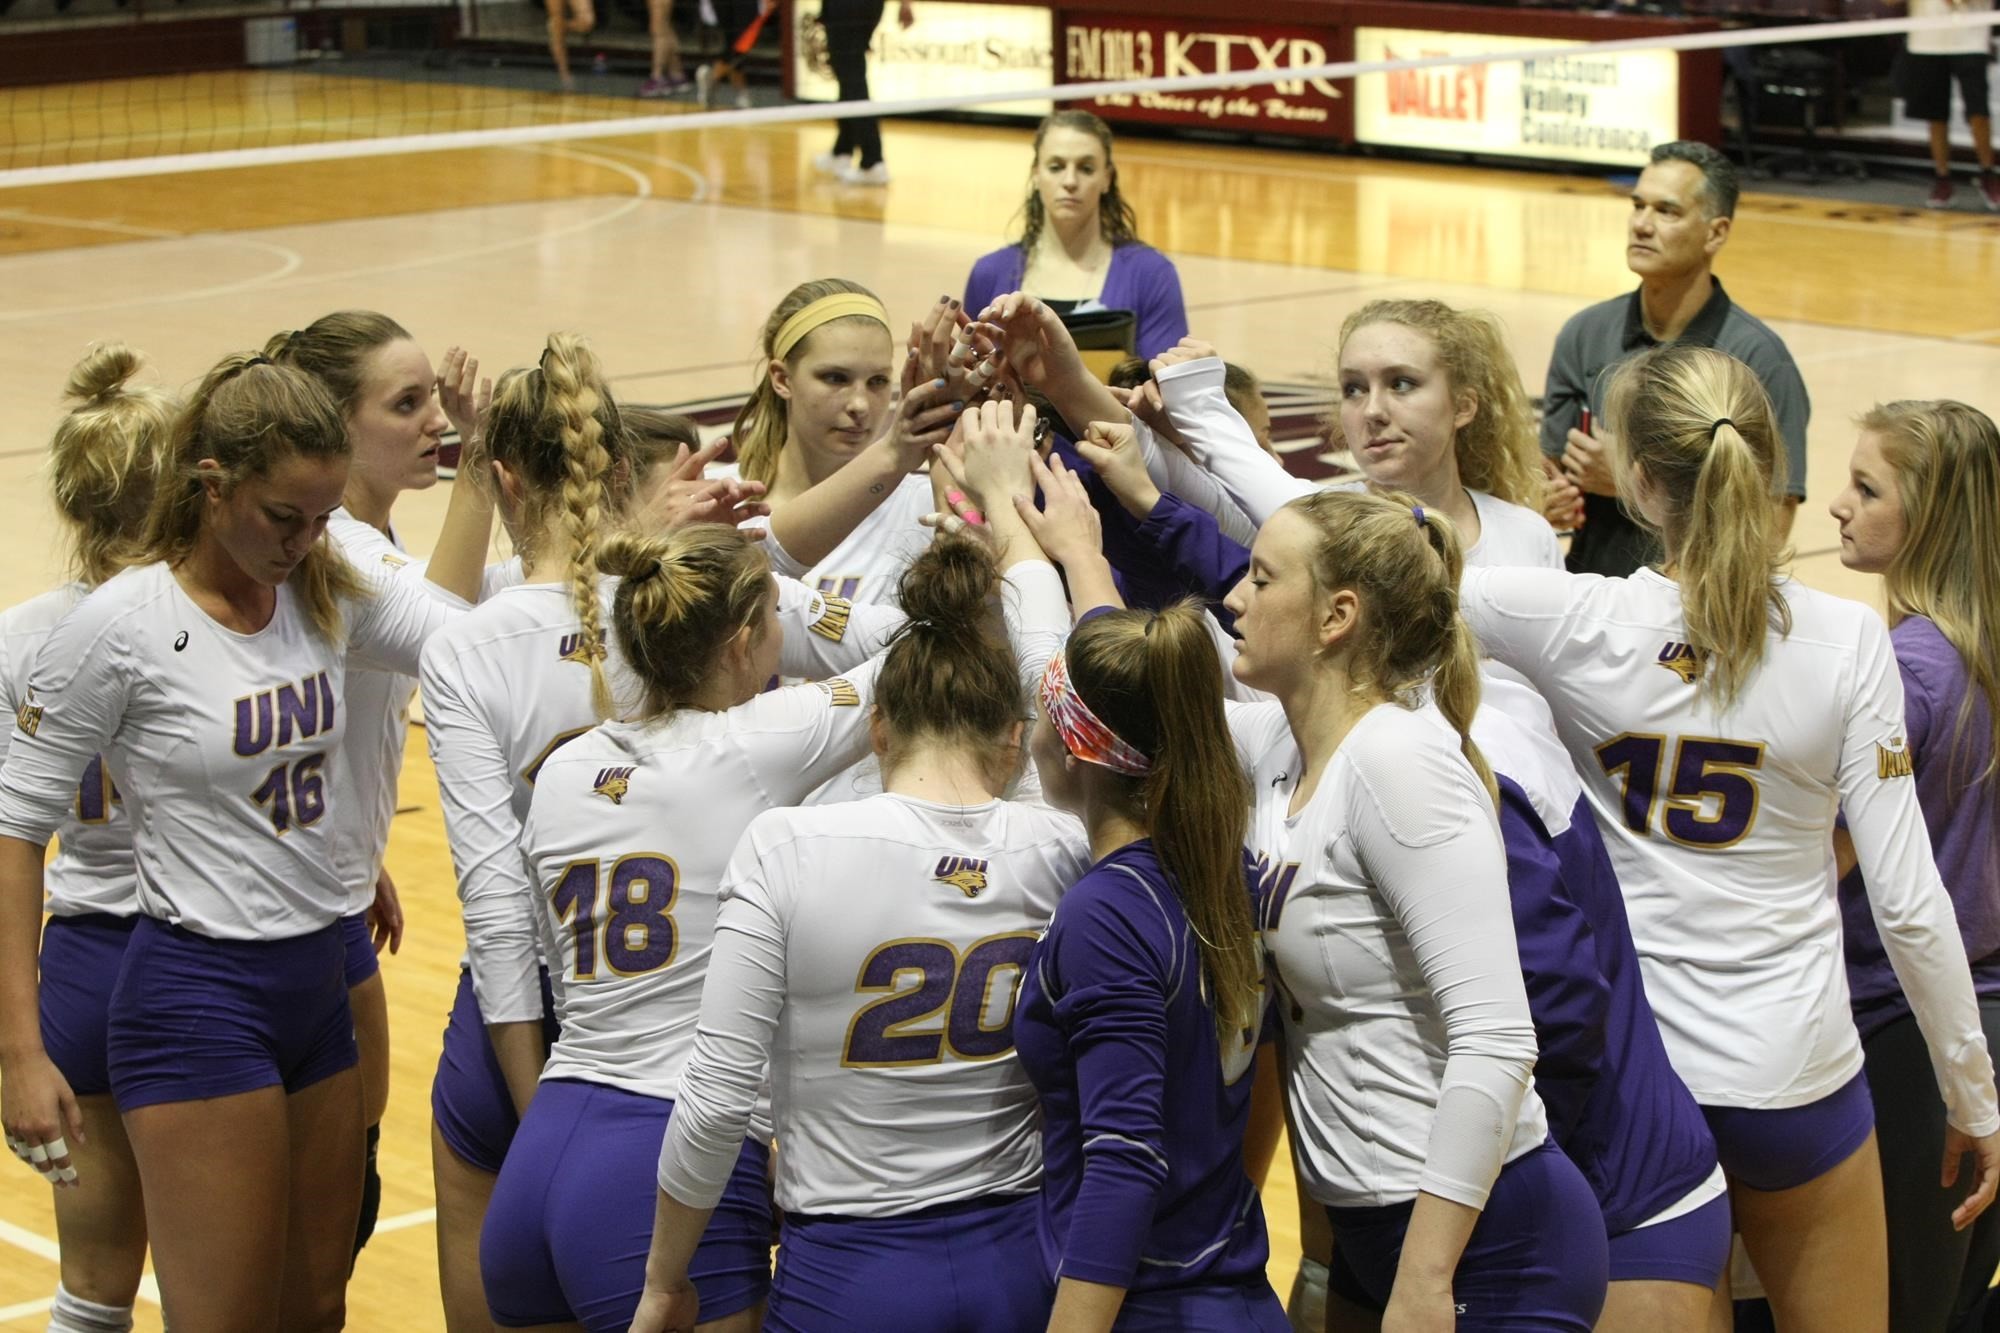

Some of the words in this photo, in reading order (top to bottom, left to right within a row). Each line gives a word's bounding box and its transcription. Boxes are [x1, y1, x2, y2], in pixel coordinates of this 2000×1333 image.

[1164, 31, 1343, 99] KTXR
[1385, 44, 1489, 122] VALLEY
[1521, 83, 1588, 118] Valley
[1198, 95, 1225, 119] of
[1225, 96, 1260, 118] the
[1520, 116, 1651, 152] Conference
[232, 671, 335, 757] UNI
[251, 754, 326, 837] 16
[594, 767, 638, 789] UNI
[1594, 733, 1765, 850] 15
[934, 855, 989, 876] UNI
[550, 850, 680, 981] 18
[840, 929, 1042, 1069] 20
